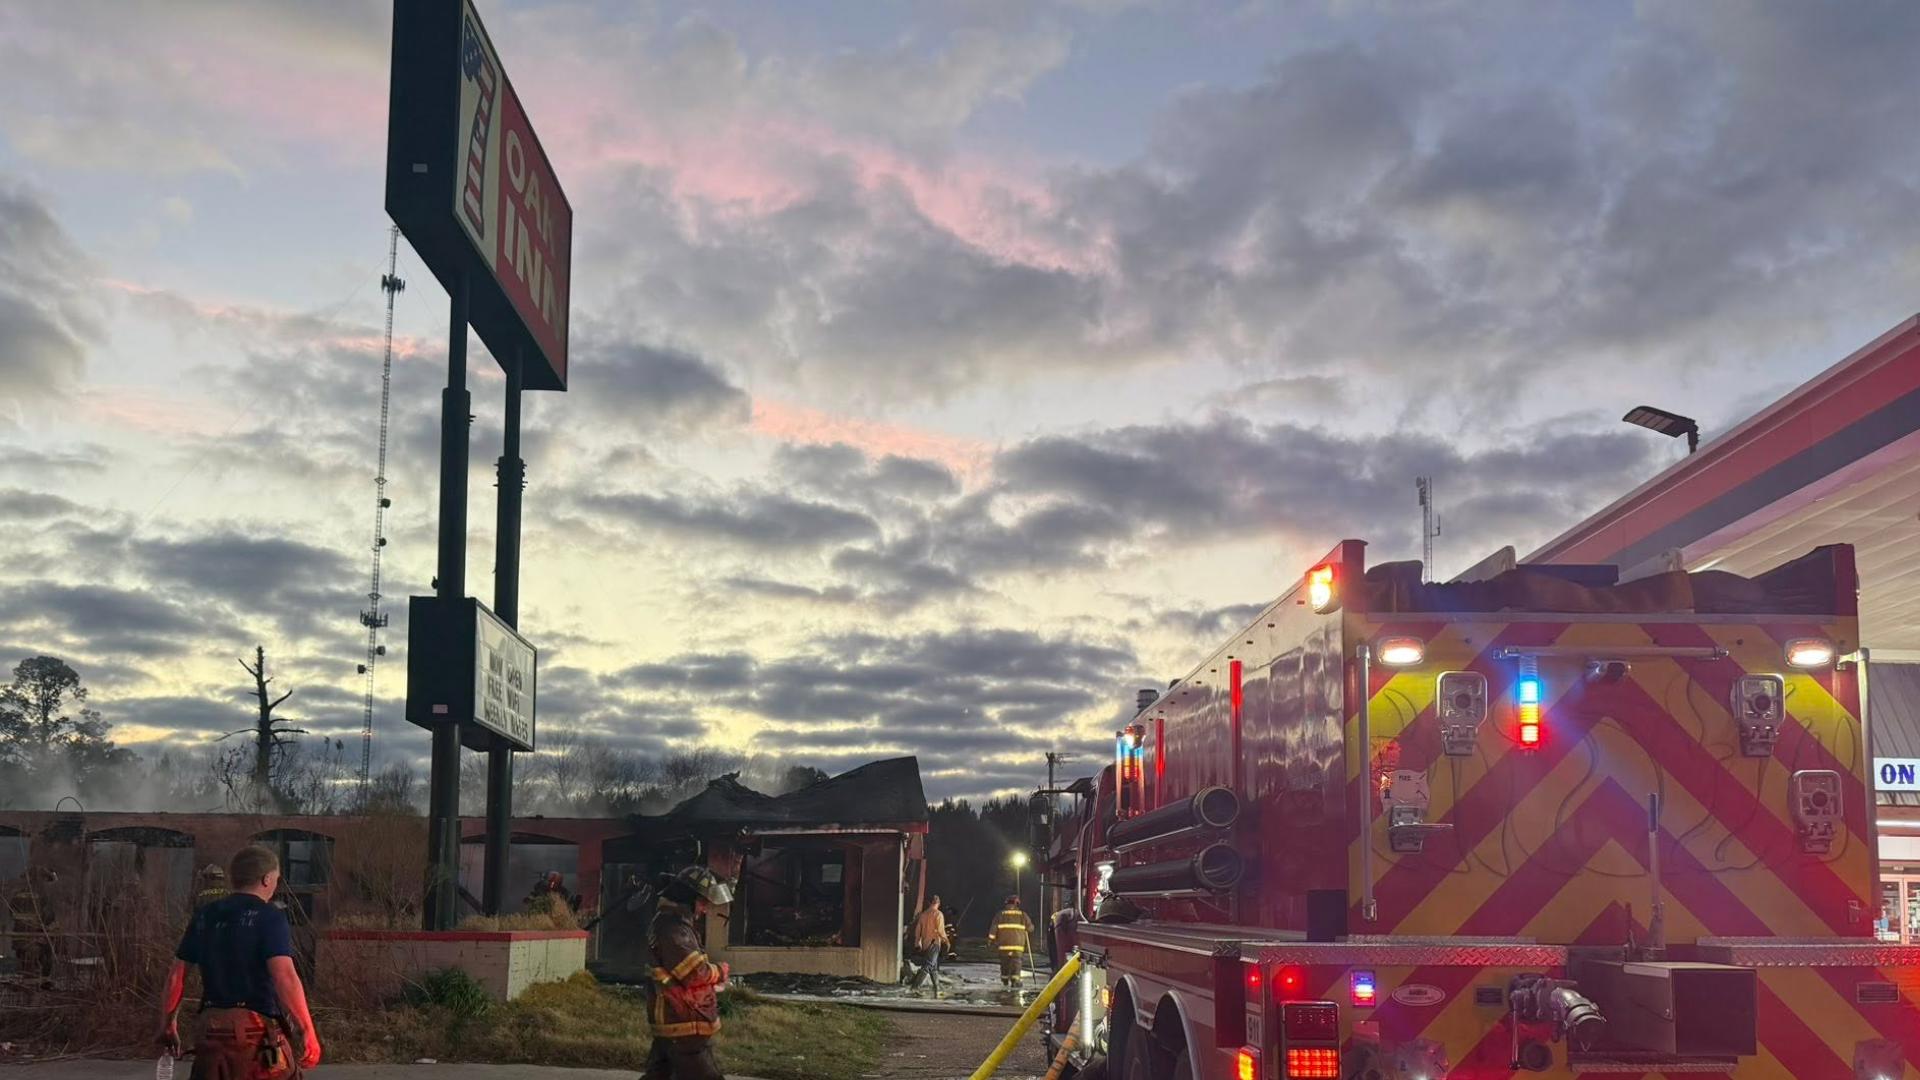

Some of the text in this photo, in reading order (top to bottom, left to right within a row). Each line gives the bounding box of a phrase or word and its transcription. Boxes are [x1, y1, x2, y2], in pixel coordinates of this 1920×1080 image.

[503, 194, 565, 354] INN
[487, 673, 502, 703] FREE
[1880, 763, 1915, 784] ON
